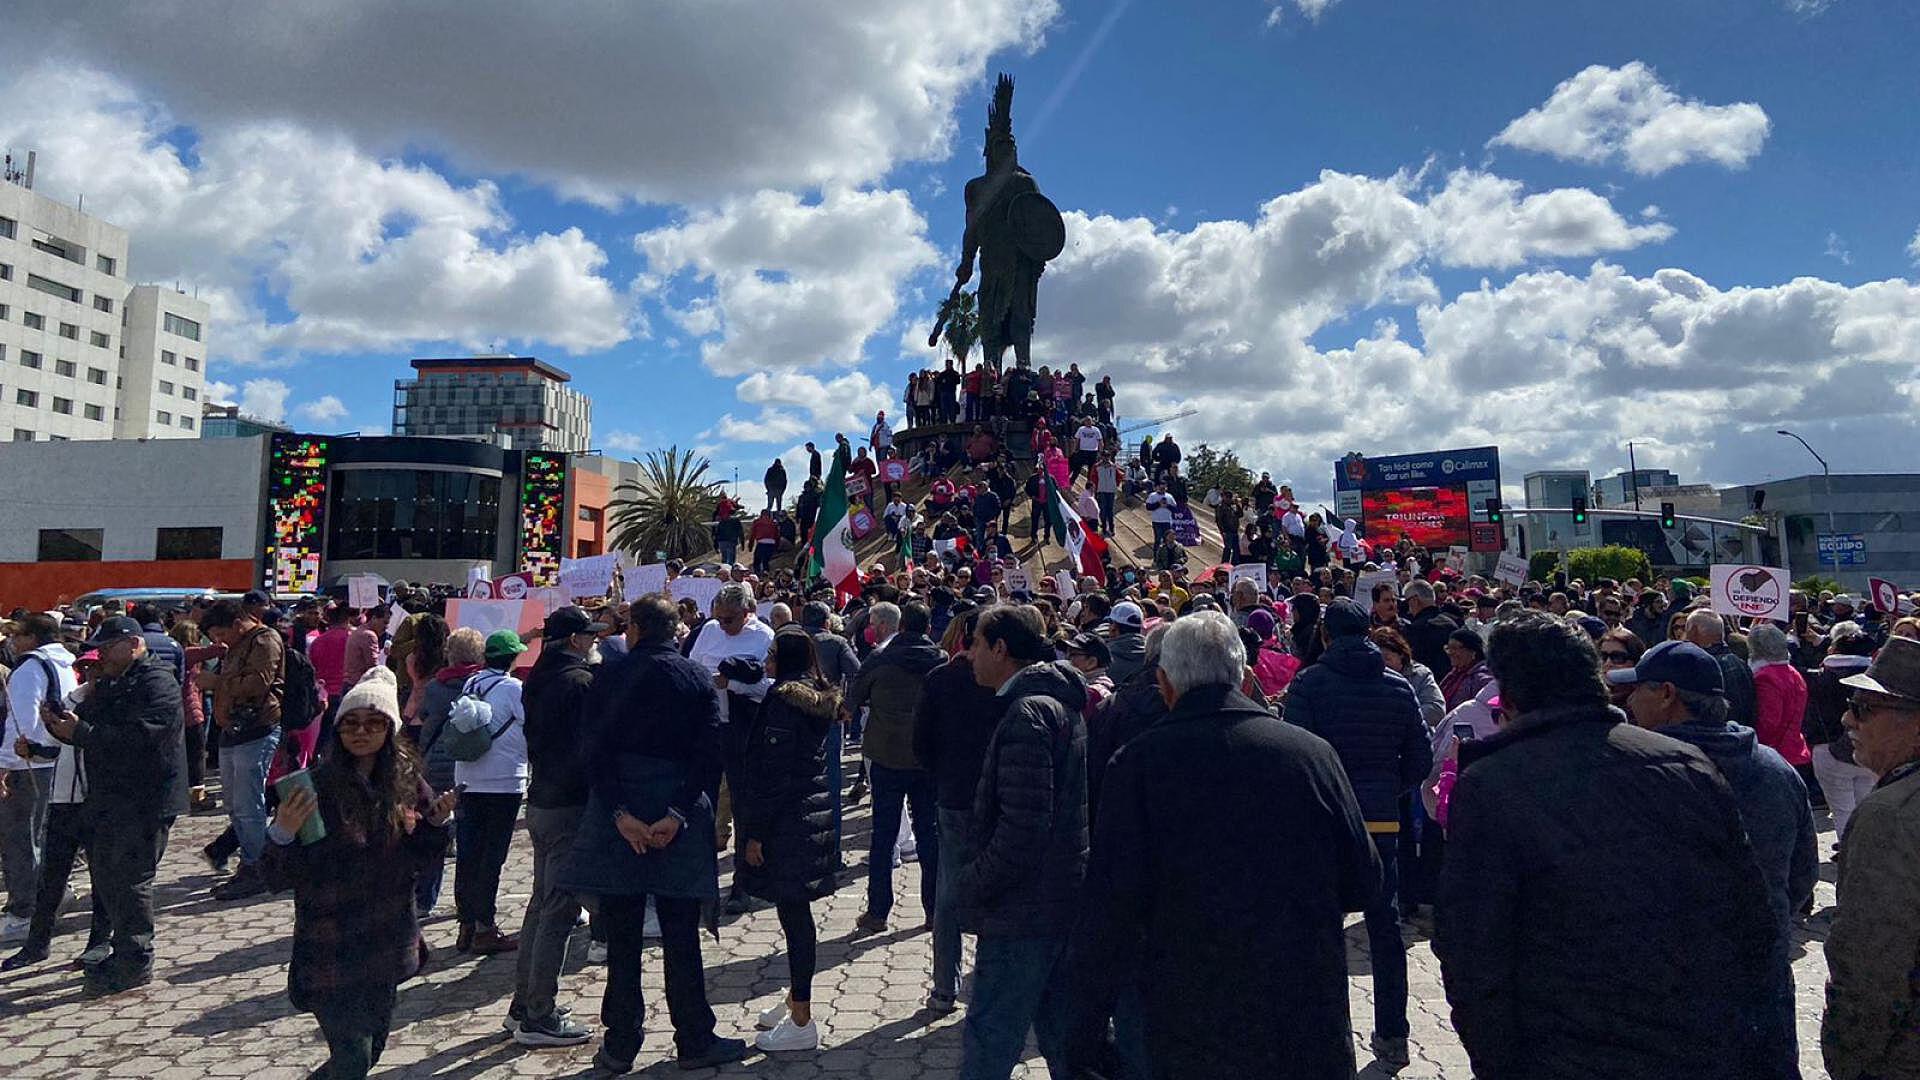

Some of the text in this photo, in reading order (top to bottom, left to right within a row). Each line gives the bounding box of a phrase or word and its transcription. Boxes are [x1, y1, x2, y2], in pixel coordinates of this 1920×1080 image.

[1411, 461, 1434, 470] como
[1455, 461, 1489, 471] Calimax
[1819, 541, 1863, 551] EQUIPO
[1733, 594, 1779, 605] DEFIENDO
